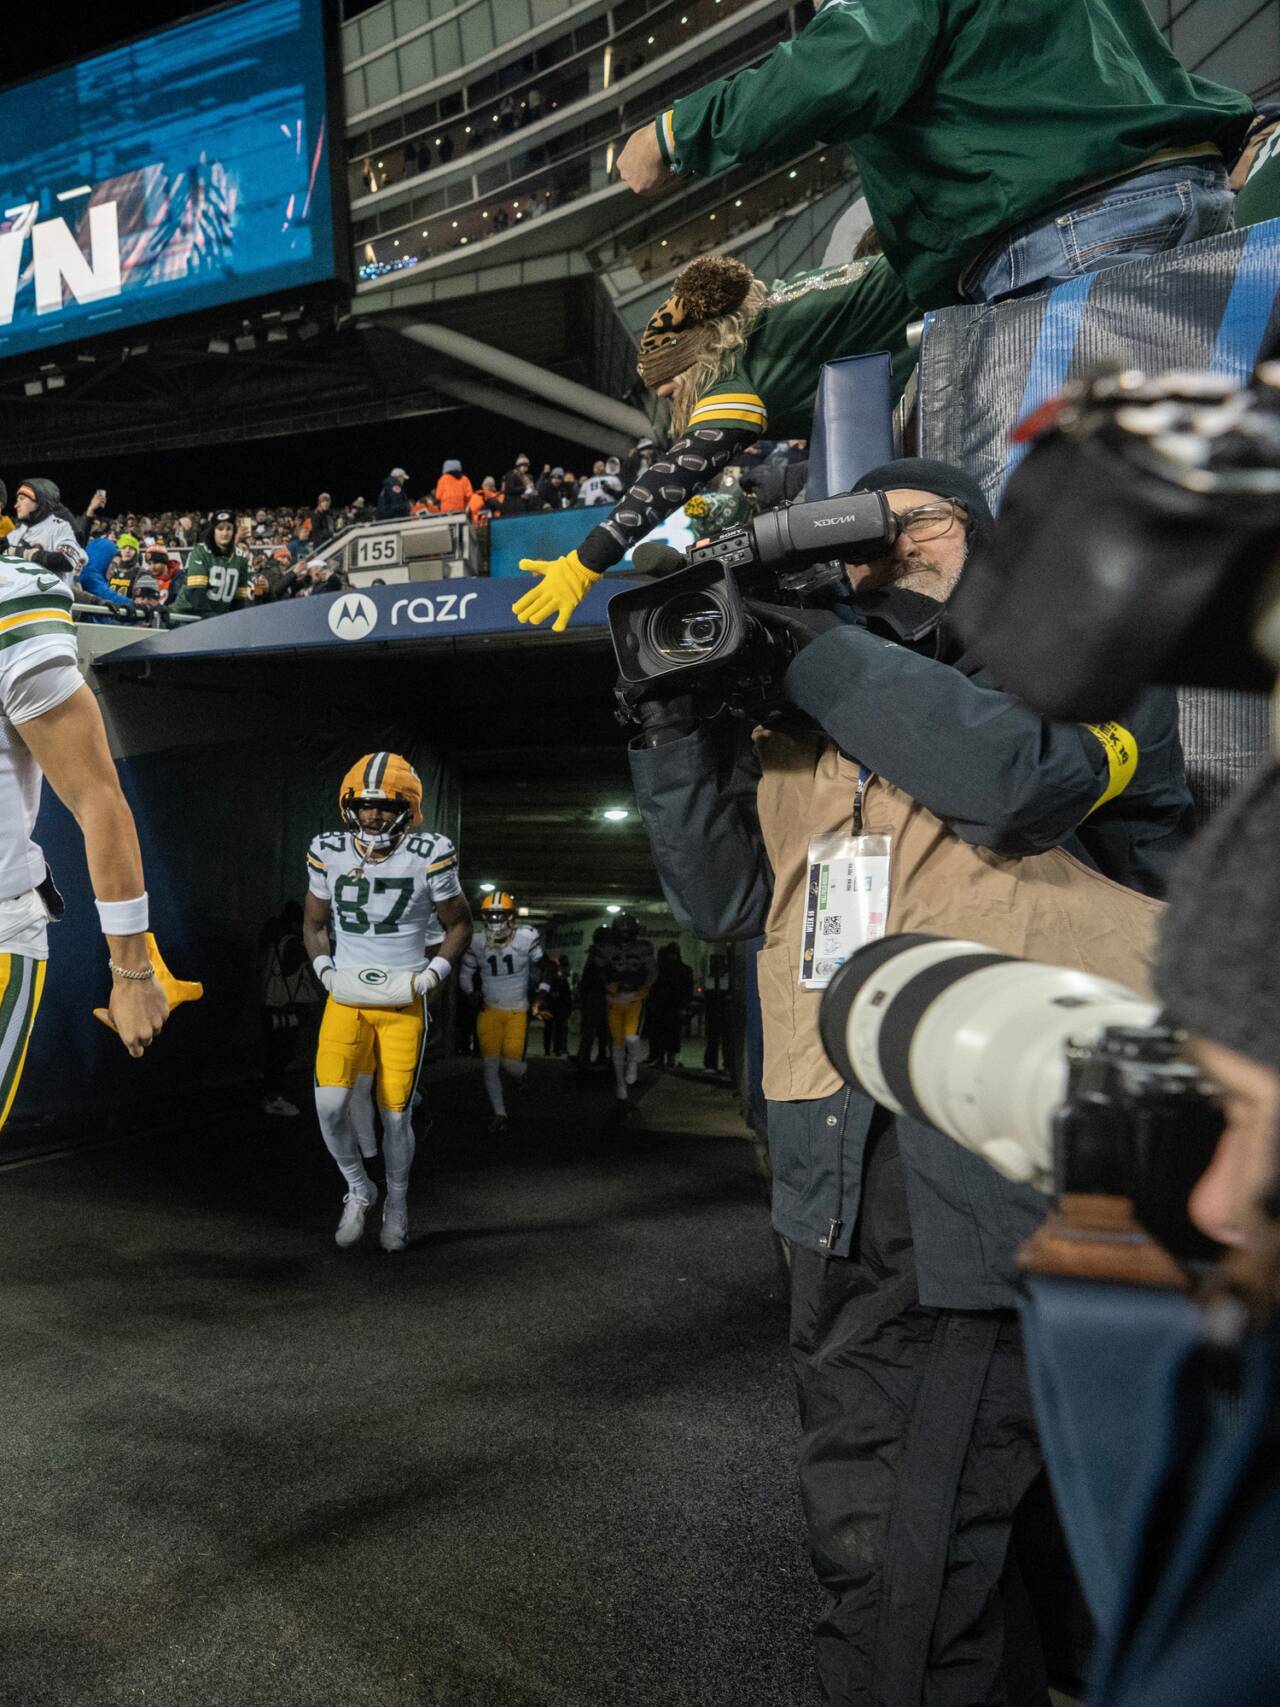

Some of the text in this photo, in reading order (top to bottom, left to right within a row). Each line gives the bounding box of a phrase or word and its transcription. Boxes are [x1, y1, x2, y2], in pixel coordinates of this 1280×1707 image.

[813, 514, 856, 528] XDCAM
[359, 540, 395, 562] 155
[206, 566, 240, 602] 90
[391, 592, 478, 626] razr
[334, 874, 415, 935] 87
[805, 917, 815, 933] WEEK
[487, 954, 515, 976] 11
